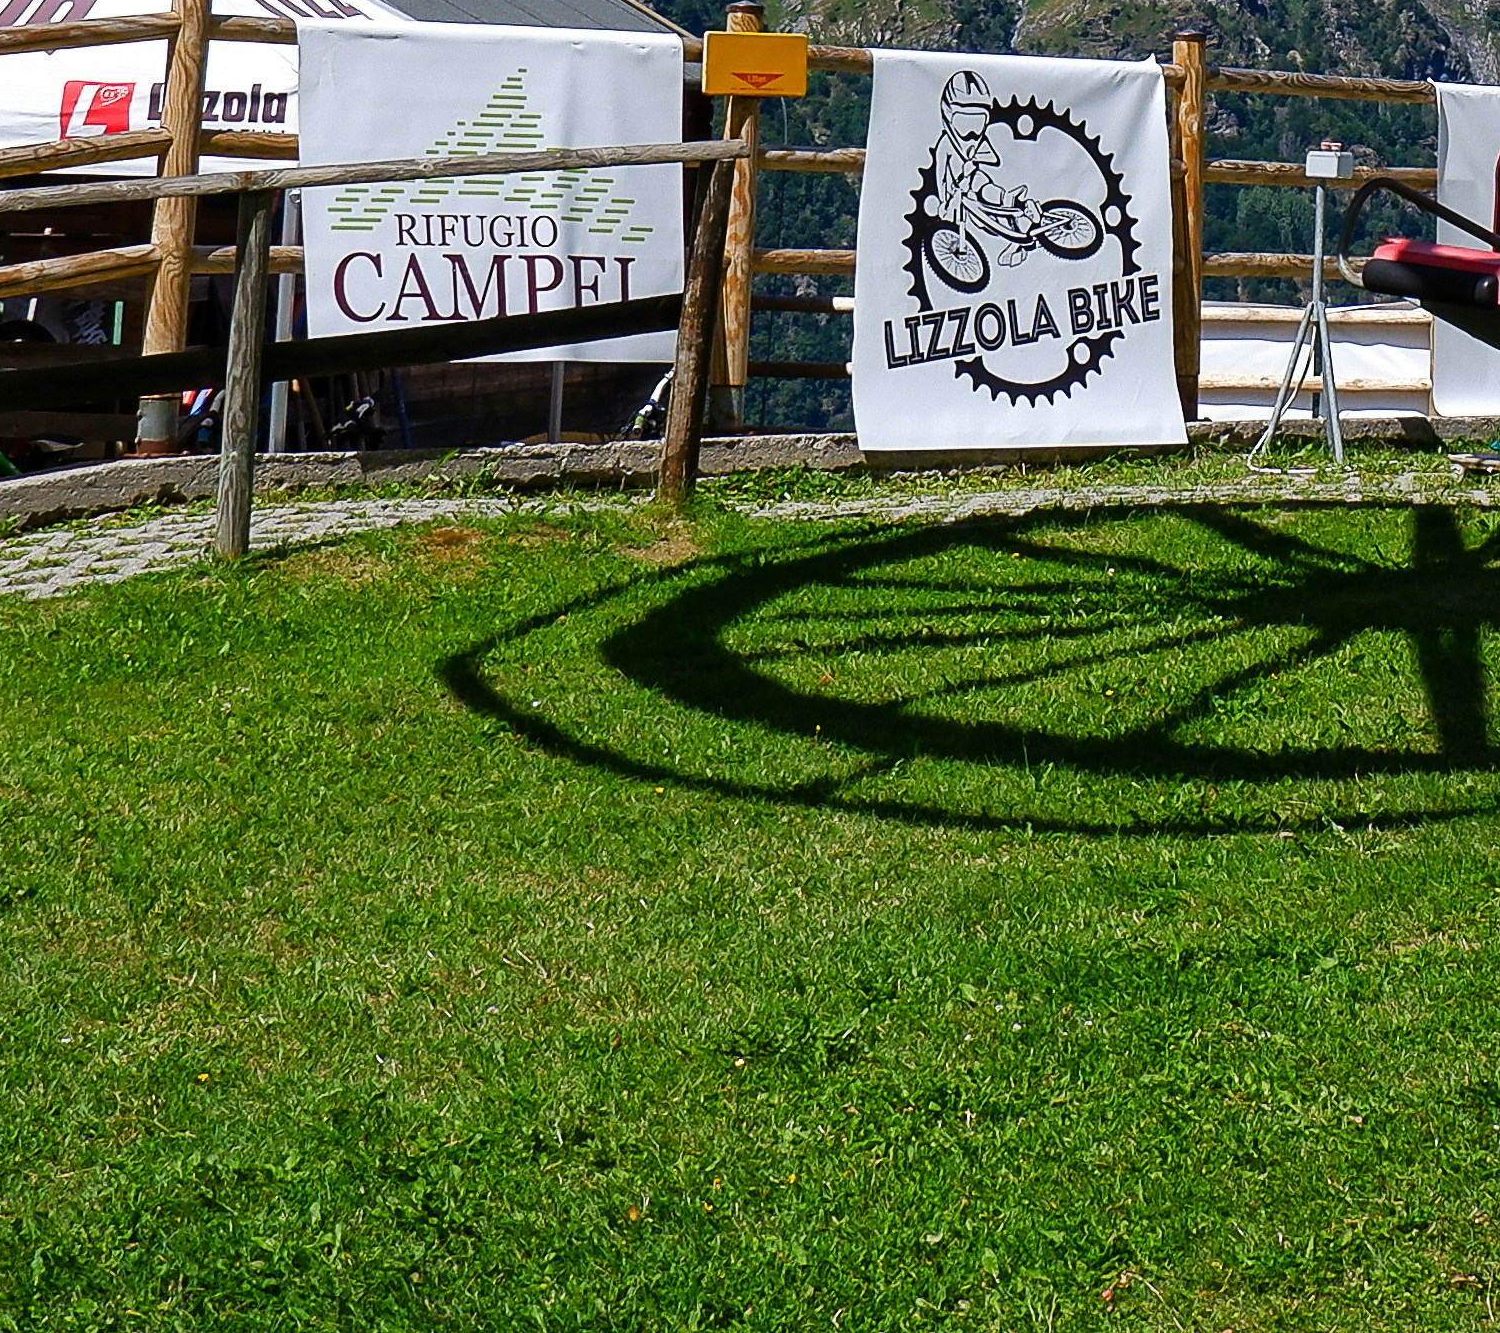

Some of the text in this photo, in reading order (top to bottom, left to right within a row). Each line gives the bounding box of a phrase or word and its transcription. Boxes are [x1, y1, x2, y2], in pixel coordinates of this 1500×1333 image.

[147, 83, 289, 124] Lzola
[394, 213, 559, 248] RIFUGIO
[884, 274, 1161, 370] LIZZOLA BIKE
